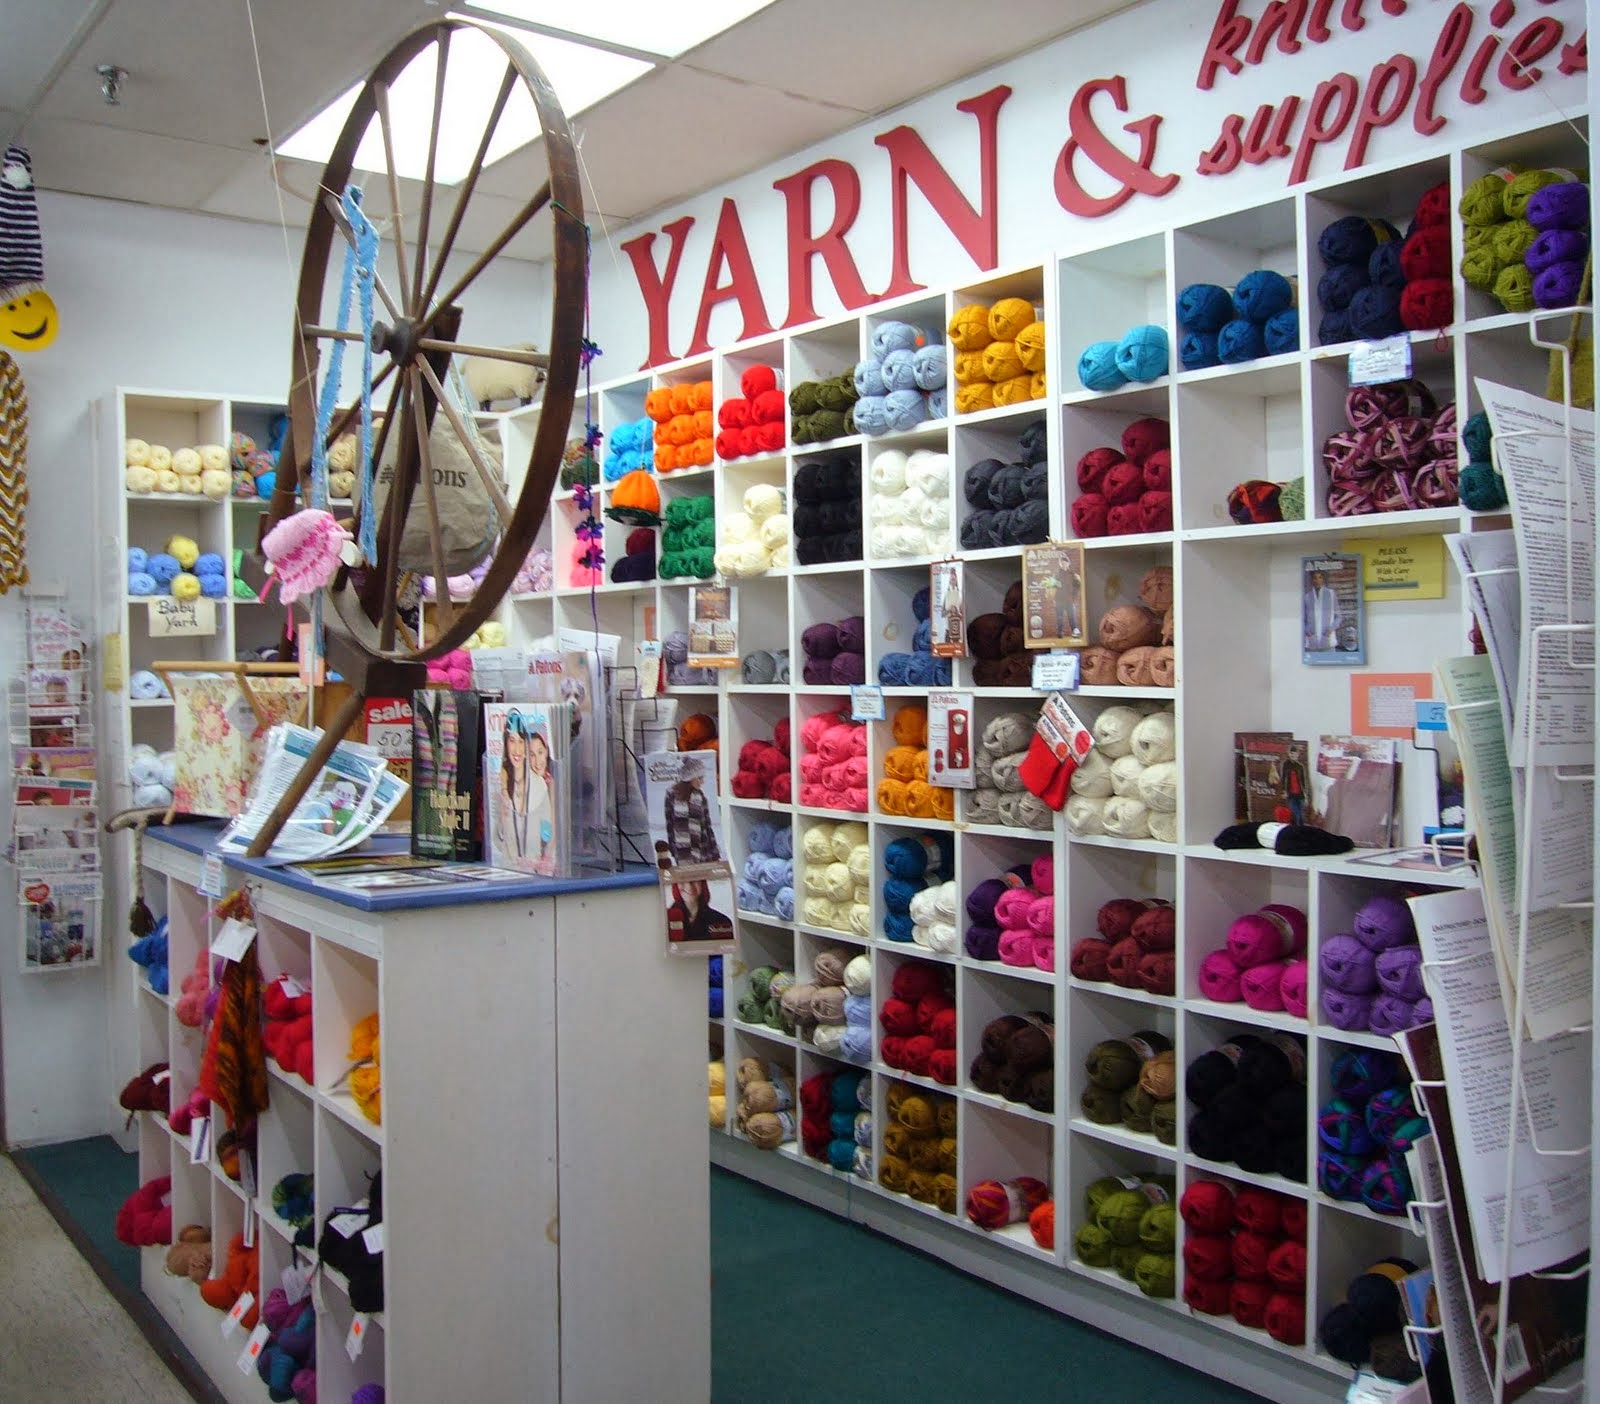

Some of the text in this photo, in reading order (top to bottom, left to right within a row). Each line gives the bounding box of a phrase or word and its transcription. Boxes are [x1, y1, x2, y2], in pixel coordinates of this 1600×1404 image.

[620, 75, 1181, 371] YARN &
[156, 600, 196, 619] Baby
[165, 616, 198, 632] Yarn
[369, 701, 413, 723] sale
